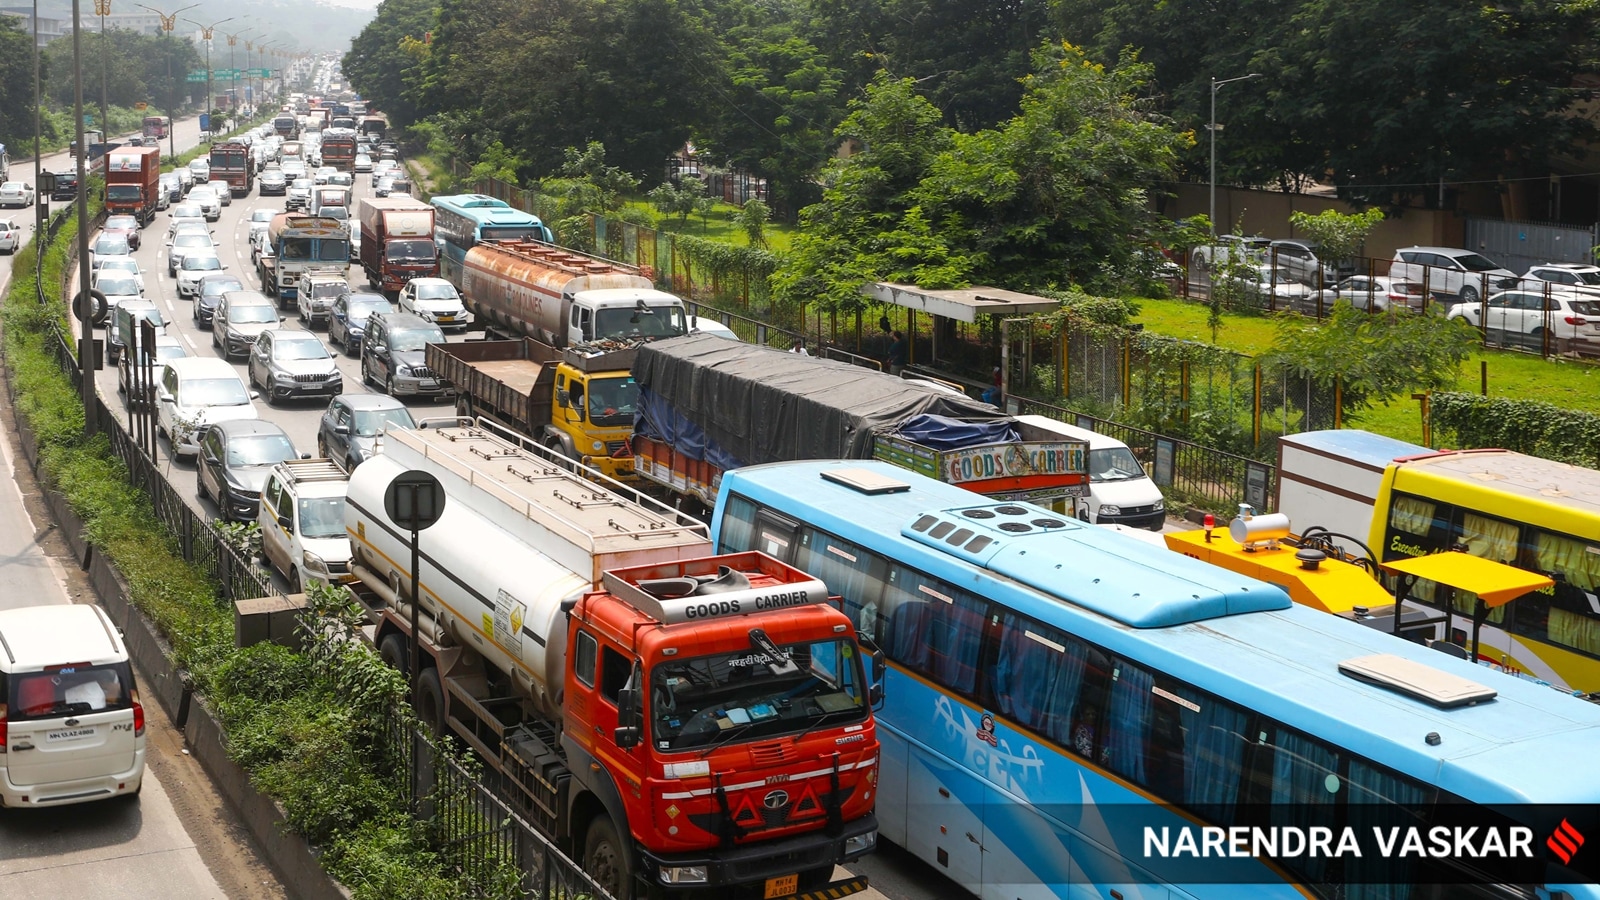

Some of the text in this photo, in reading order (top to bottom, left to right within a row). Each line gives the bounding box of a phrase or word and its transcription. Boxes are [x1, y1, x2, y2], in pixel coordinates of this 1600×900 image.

[950, 449, 1083, 481] GOODS CARRIER
[685, 591, 809, 619] GOODS CARRIER
[835, 734, 864, 745] SIGNA
[765, 774, 791, 785] TATA
[775, 878, 793, 887] MH14
[770, 884, 796, 897] JL0033
